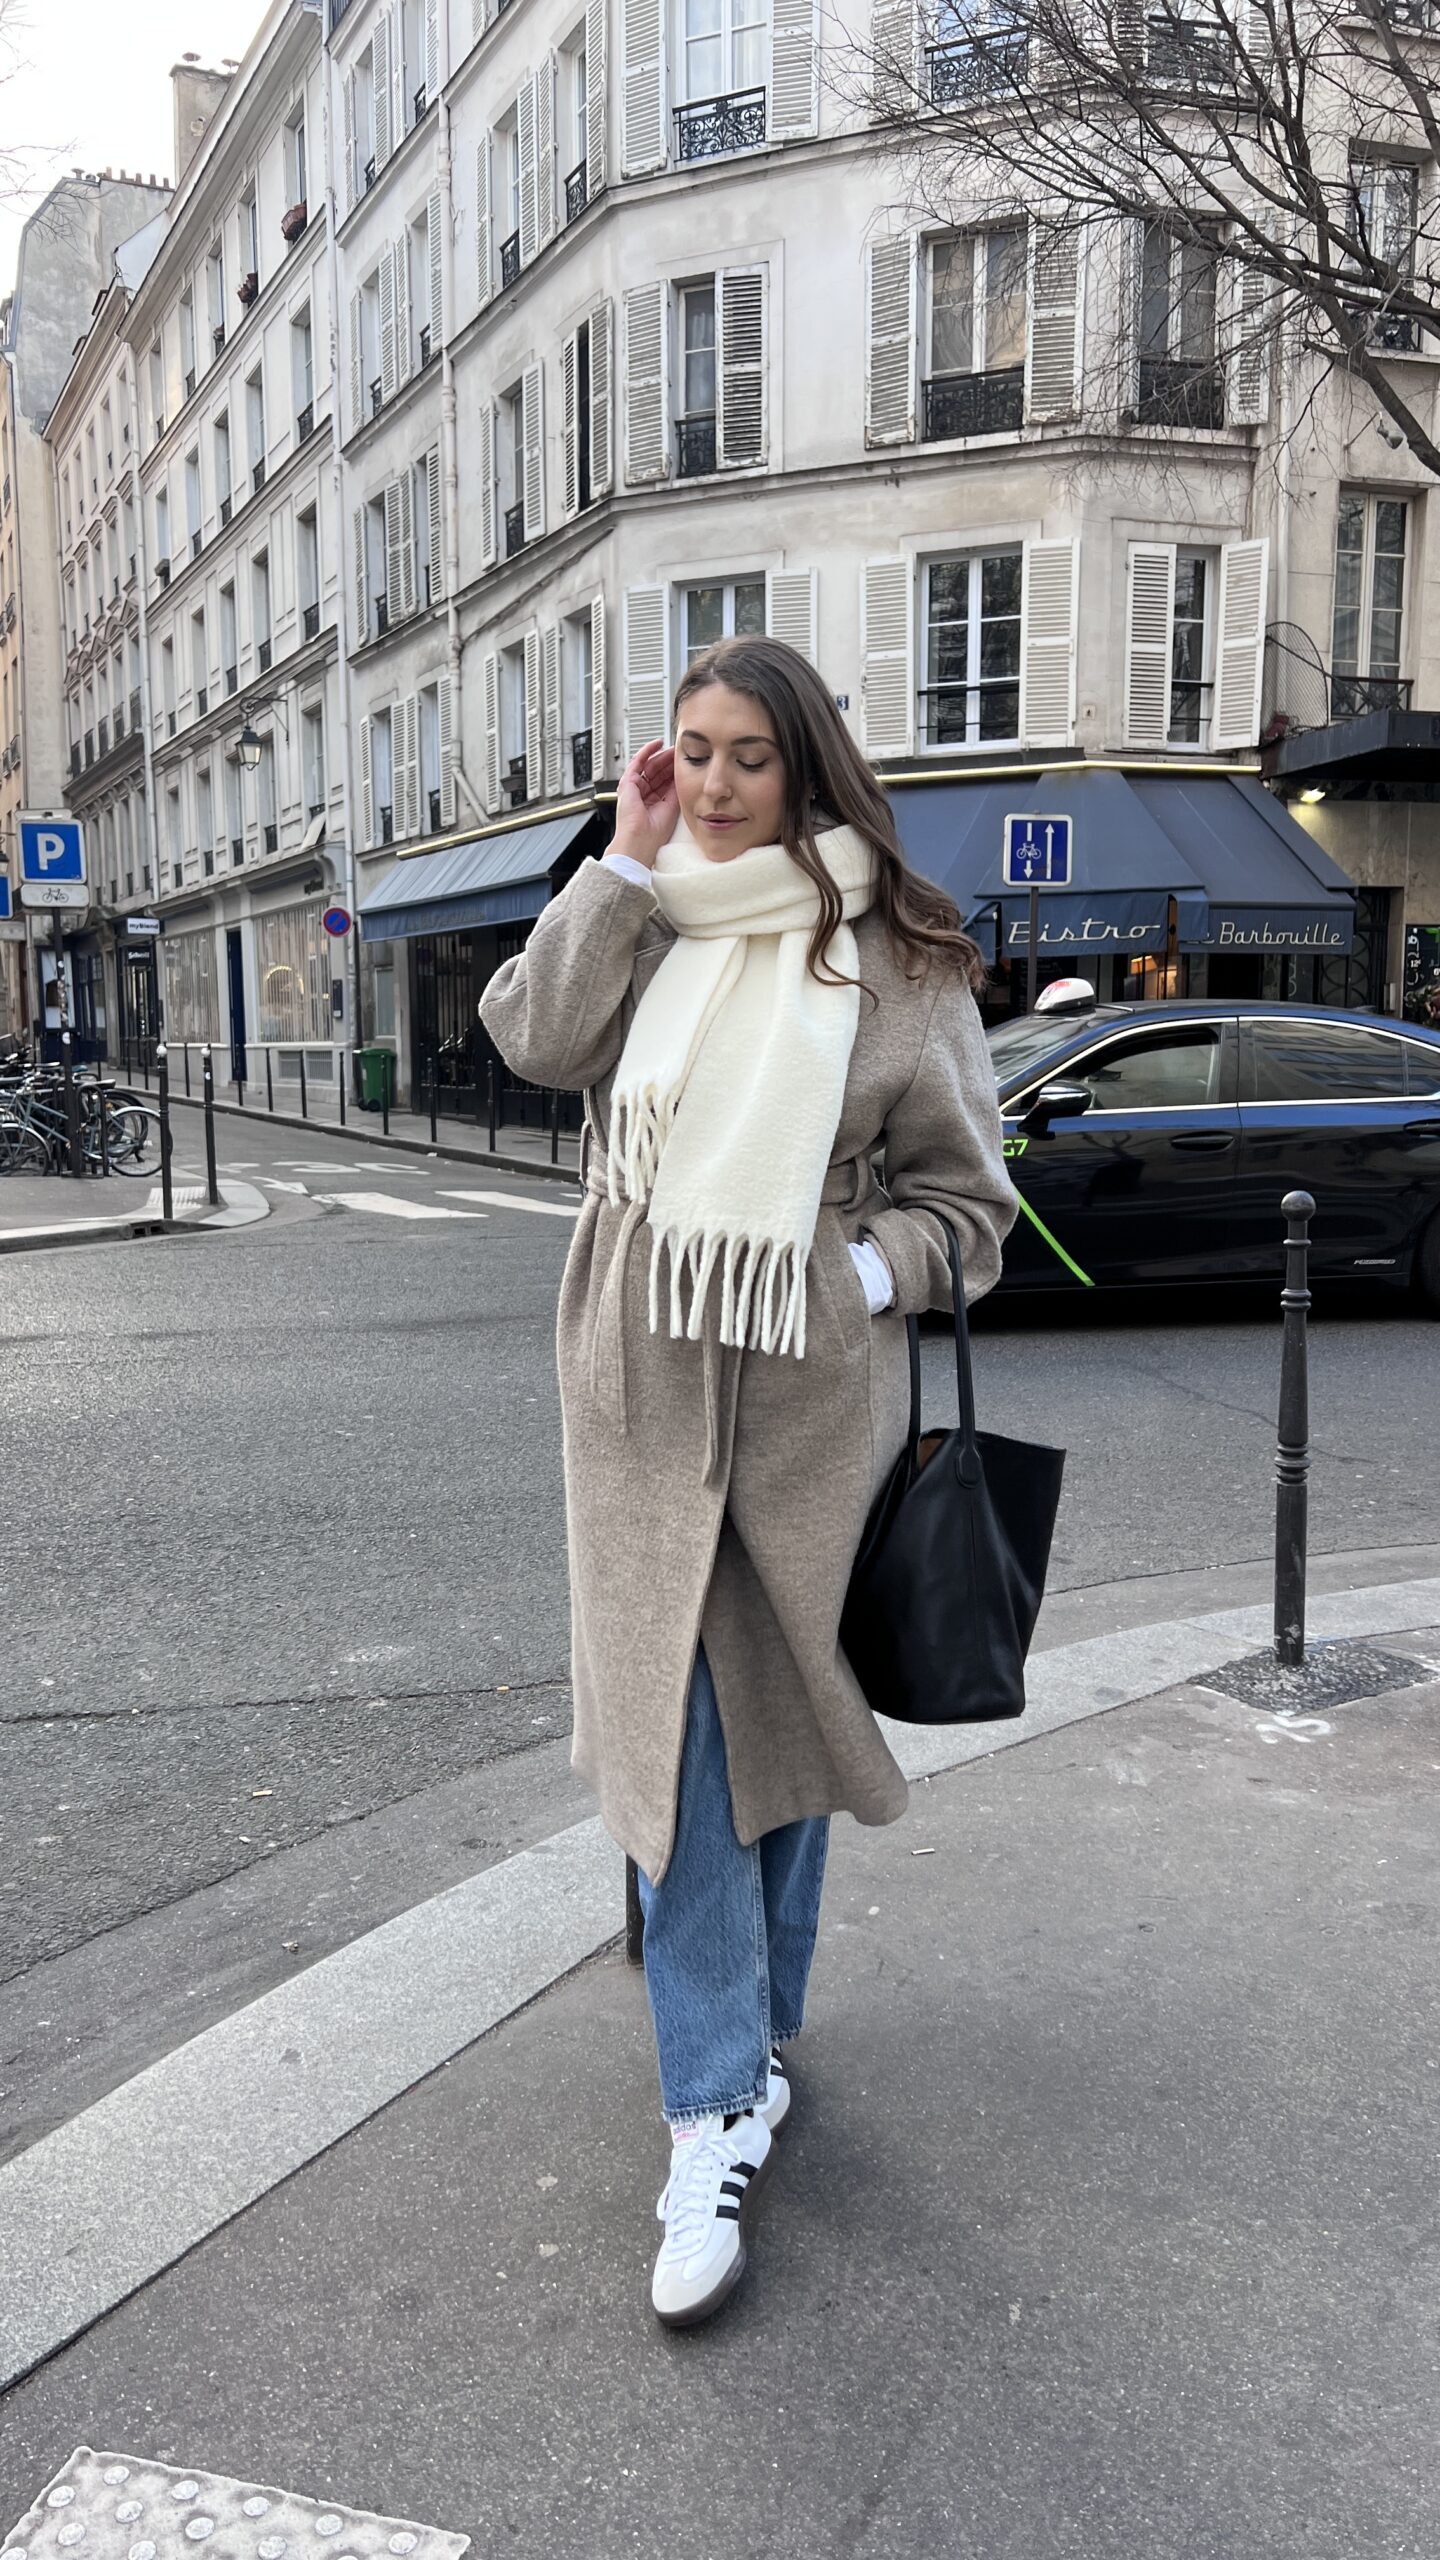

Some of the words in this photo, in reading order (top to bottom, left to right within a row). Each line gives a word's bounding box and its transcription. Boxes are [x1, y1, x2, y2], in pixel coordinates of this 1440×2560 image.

[838, 696, 846, 710] 3
[37, 833, 65, 871] P
[1008, 918, 1161, 944] Bistro
[1219, 921, 1346, 946] Barbouille
[1003, 1138, 1029, 1157] G7
